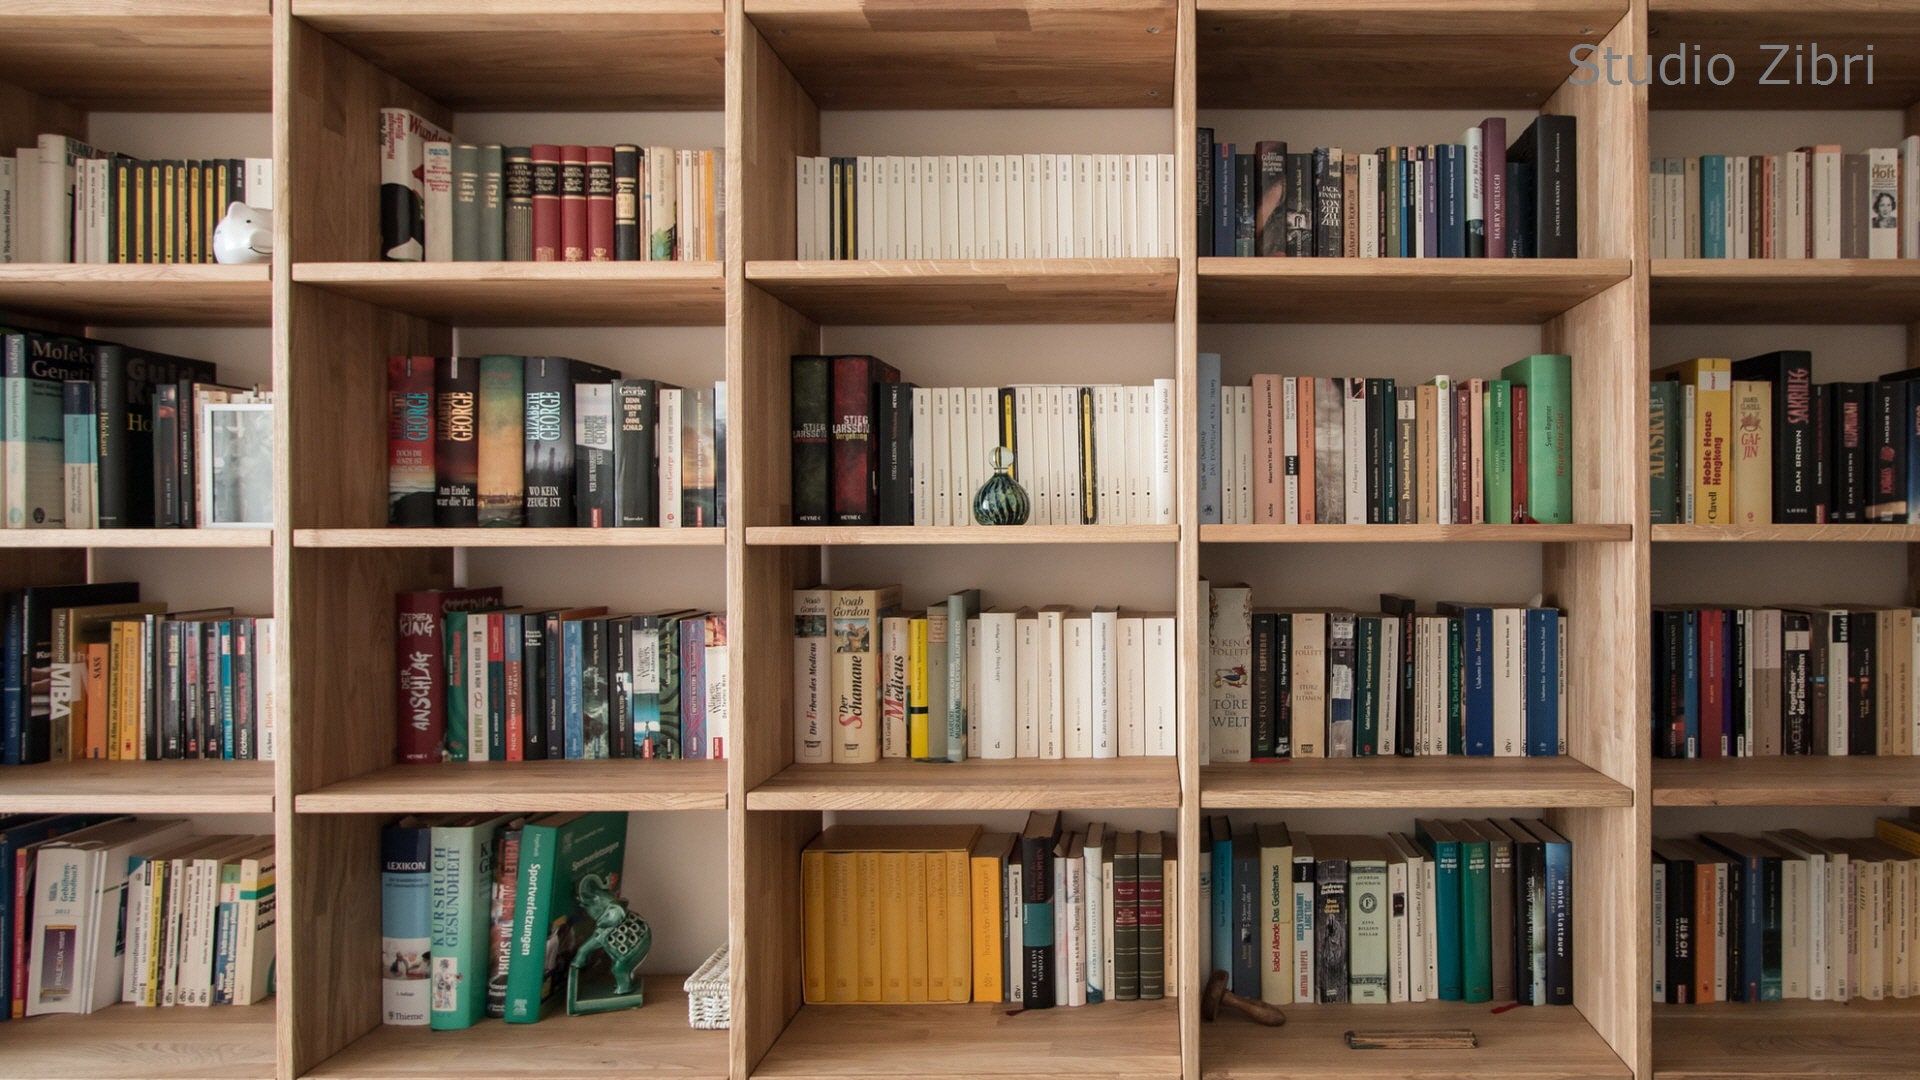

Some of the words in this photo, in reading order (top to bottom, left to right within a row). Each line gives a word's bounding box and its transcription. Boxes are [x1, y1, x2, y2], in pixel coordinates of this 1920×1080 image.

[1787, 368, 1809, 424] SAKRILEG
[407, 392, 429, 442] GEORGE
[451, 392, 474, 442] GEORGE
[526, 392, 540, 441] ELIZABETH
[540, 392, 561, 441] GEORGE
[803, 423, 826, 431] STIEG
[844, 415, 868, 424] STIEG
[1545, 405, 1553, 430] Regener
[793, 430, 827, 438] LARSSON
[833, 424, 870, 434] LARSSON
[1703, 411, 1712, 447] House
[1649, 409, 1665, 479] ALASKA
[1703, 449, 1712, 485] Noble
[1713, 437, 1724, 486] Hongkong
[436, 498, 449, 507] war
[449, 497, 461, 507] die
[462, 497, 476, 507] Tat
[451, 486, 471, 496] Ende
[527, 497, 548, 507] ZEUGE
[549, 497, 561, 507] IST
[528, 487, 540, 496] WO
[541, 487, 559, 496] KEIN
[1709, 491, 1717, 519] Clavell
[833, 607, 870, 617] Gordon
[838, 597, 864, 606] Noah
[641, 646, 651, 678] Walters
[809, 643, 817, 678] Medicus
[1212, 648, 1249, 656] FOLLETT
[93, 656, 102, 679] SASS
[401, 667, 411, 690] DER
[51, 663, 71, 720] MBA
[409, 651, 433, 731] ANSCHLAG
[809, 680, 817, 691] des
[839, 655, 863, 730] Schamane
[884, 655, 905, 722] Medicus
[806, 692, 817, 720] Erben
[839, 695, 849, 714] Der
[1213, 700, 1248, 710] TORE
[1797, 699, 1805, 715] der
[809, 724, 817, 736] Die
[1211, 716, 1250, 728] WELT
[1259, 721, 1267, 741] KEN
[387, 861, 426, 871] LEXIKON
[69, 864, 78, 903] Handbuch
[1271, 865, 1280, 906] Geisterhaus
[433, 847, 446, 947] KURSBUCH
[446, 848, 460, 947] GESUNDHEIT
[521, 864, 541, 956] Sportverletzungen
[1272, 908, 1280, 922] Das
[501, 920, 514, 938] IM
[1272, 923, 1280, 950] Allende
[1272, 952, 1280, 973] Isabel
[165, 992, 173, 1003] dtv
[395, 1011, 423, 1021] Thieme
